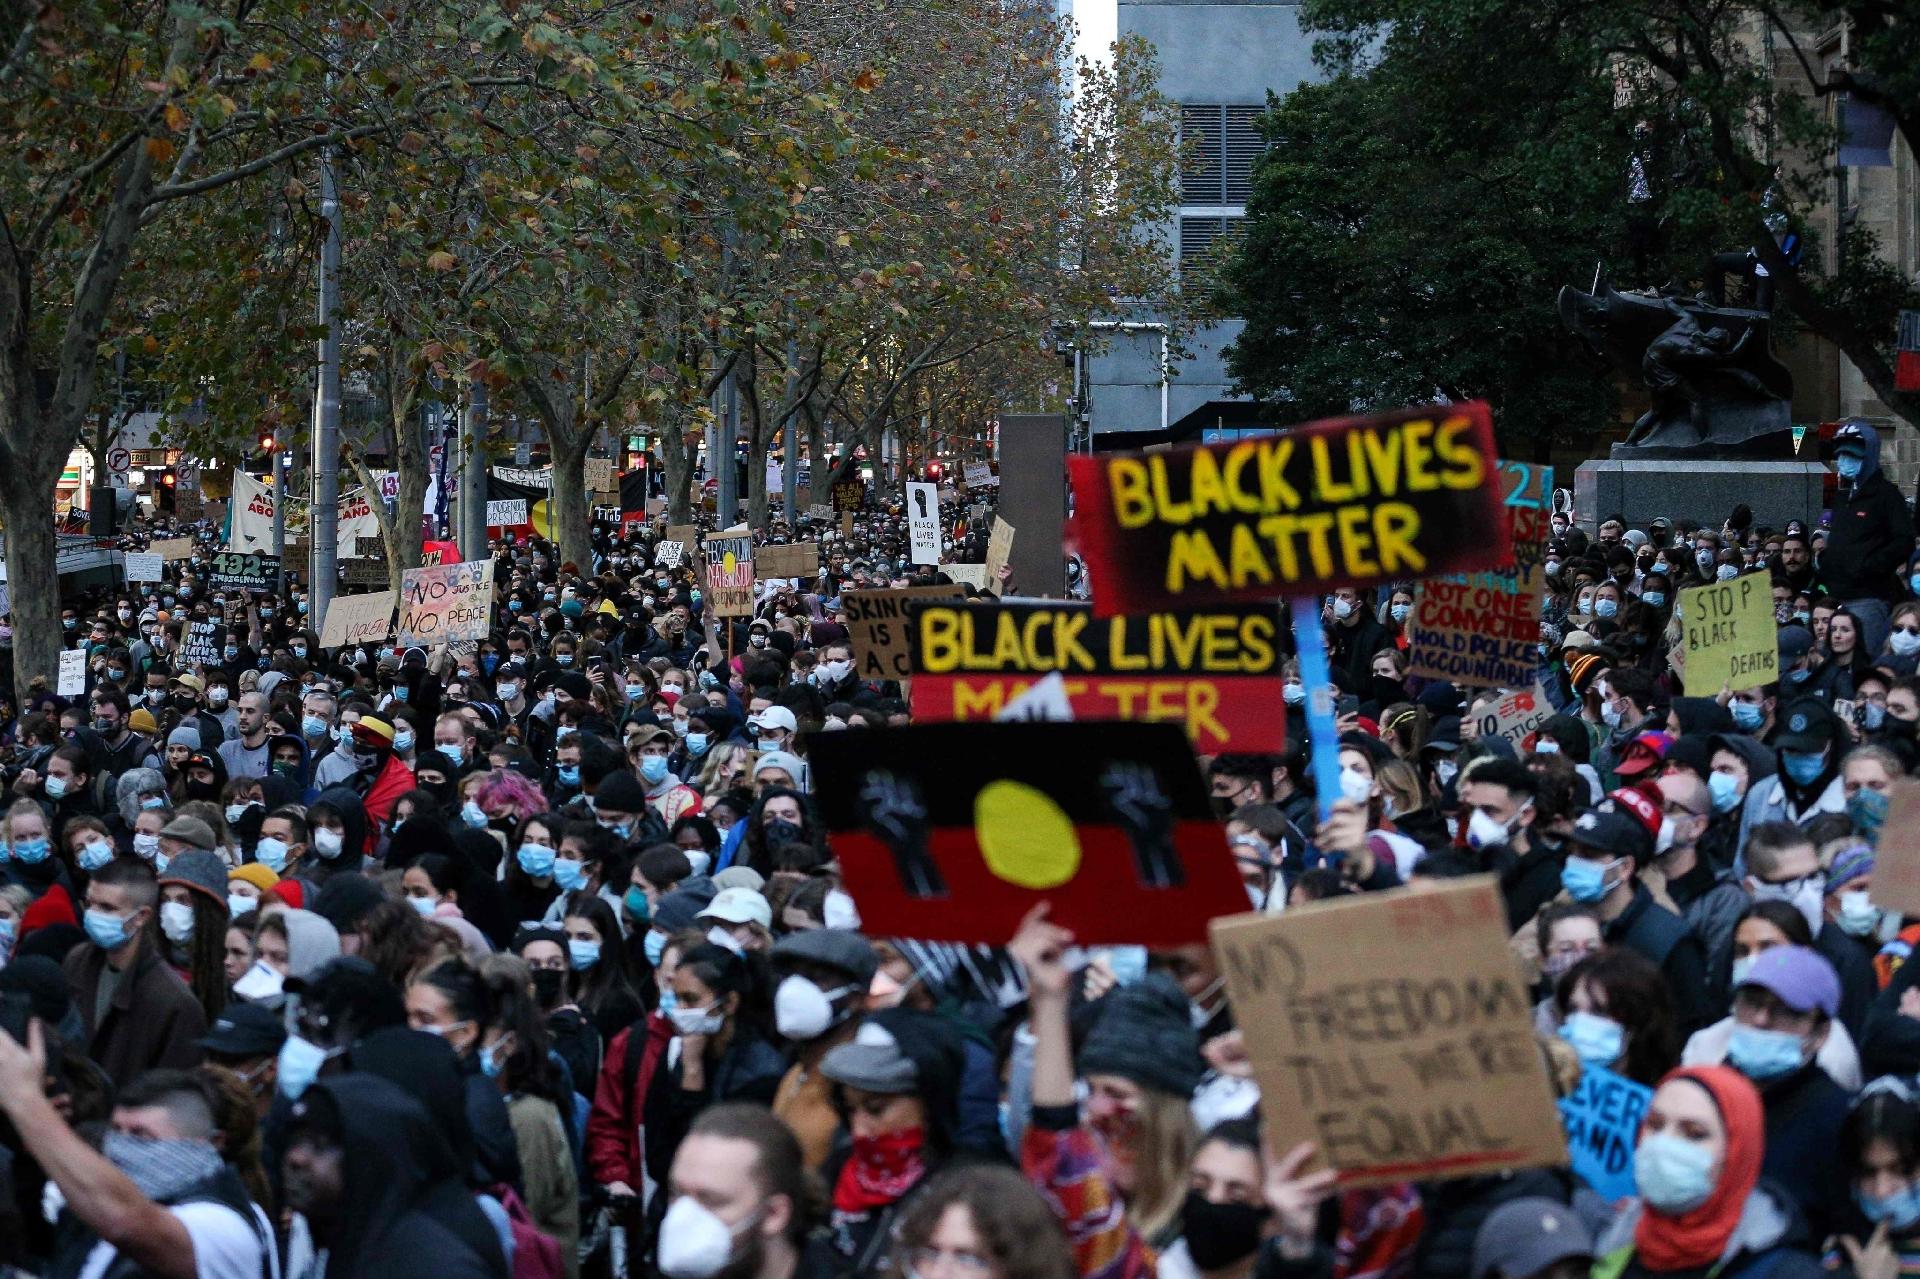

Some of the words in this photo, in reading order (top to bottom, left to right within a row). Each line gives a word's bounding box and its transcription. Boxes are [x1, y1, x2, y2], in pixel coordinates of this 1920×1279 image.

[1108, 437, 1300, 529] BLACK
[1310, 415, 1487, 502] LIVES
[338, 505, 370, 520] AND
[914, 521, 935, 529] BLACK
[915, 541, 935, 549] MATTER
[916, 531, 934, 539] LIVES
[1166, 503, 1428, 593] MATTER
[212, 553, 261, 577] 432
[410, 581, 448, 605] NO
[451, 580, 489, 594] JUSTICE
[1423, 579, 1471, 606] NOT
[1474, 588, 1534, 618] ONE
[1696, 580, 1752, 621] STOP
[400, 611, 438, 633] NO
[448, 605, 486, 625] PEACE
[844, 595, 898, 621] SKIN
[187, 633, 215, 648] BLAK
[190, 622, 216, 634] STOP
[869, 624, 891, 646] IS
[919, 606, 1096, 673] BLACK
[1109, 613, 1276, 672] LIVES
[1689, 620, 1737, 650] BLACK
[179, 644, 219, 658] DEATHS
[1414, 627, 1465, 652] HOLD
[1470, 634, 1538, 664] POLICE
[1412, 648, 1538, 686] ACCOUNTABLE
[1731, 650, 1775, 677] DEATHS
[952, 681, 1231, 743] MTER
[1225, 934, 1306, 997] NO
[1286, 975, 1525, 1046] FREEDOM
[1283, 1047, 1388, 1108] TILL
[1316, 1102, 1513, 1170] EQUAL
